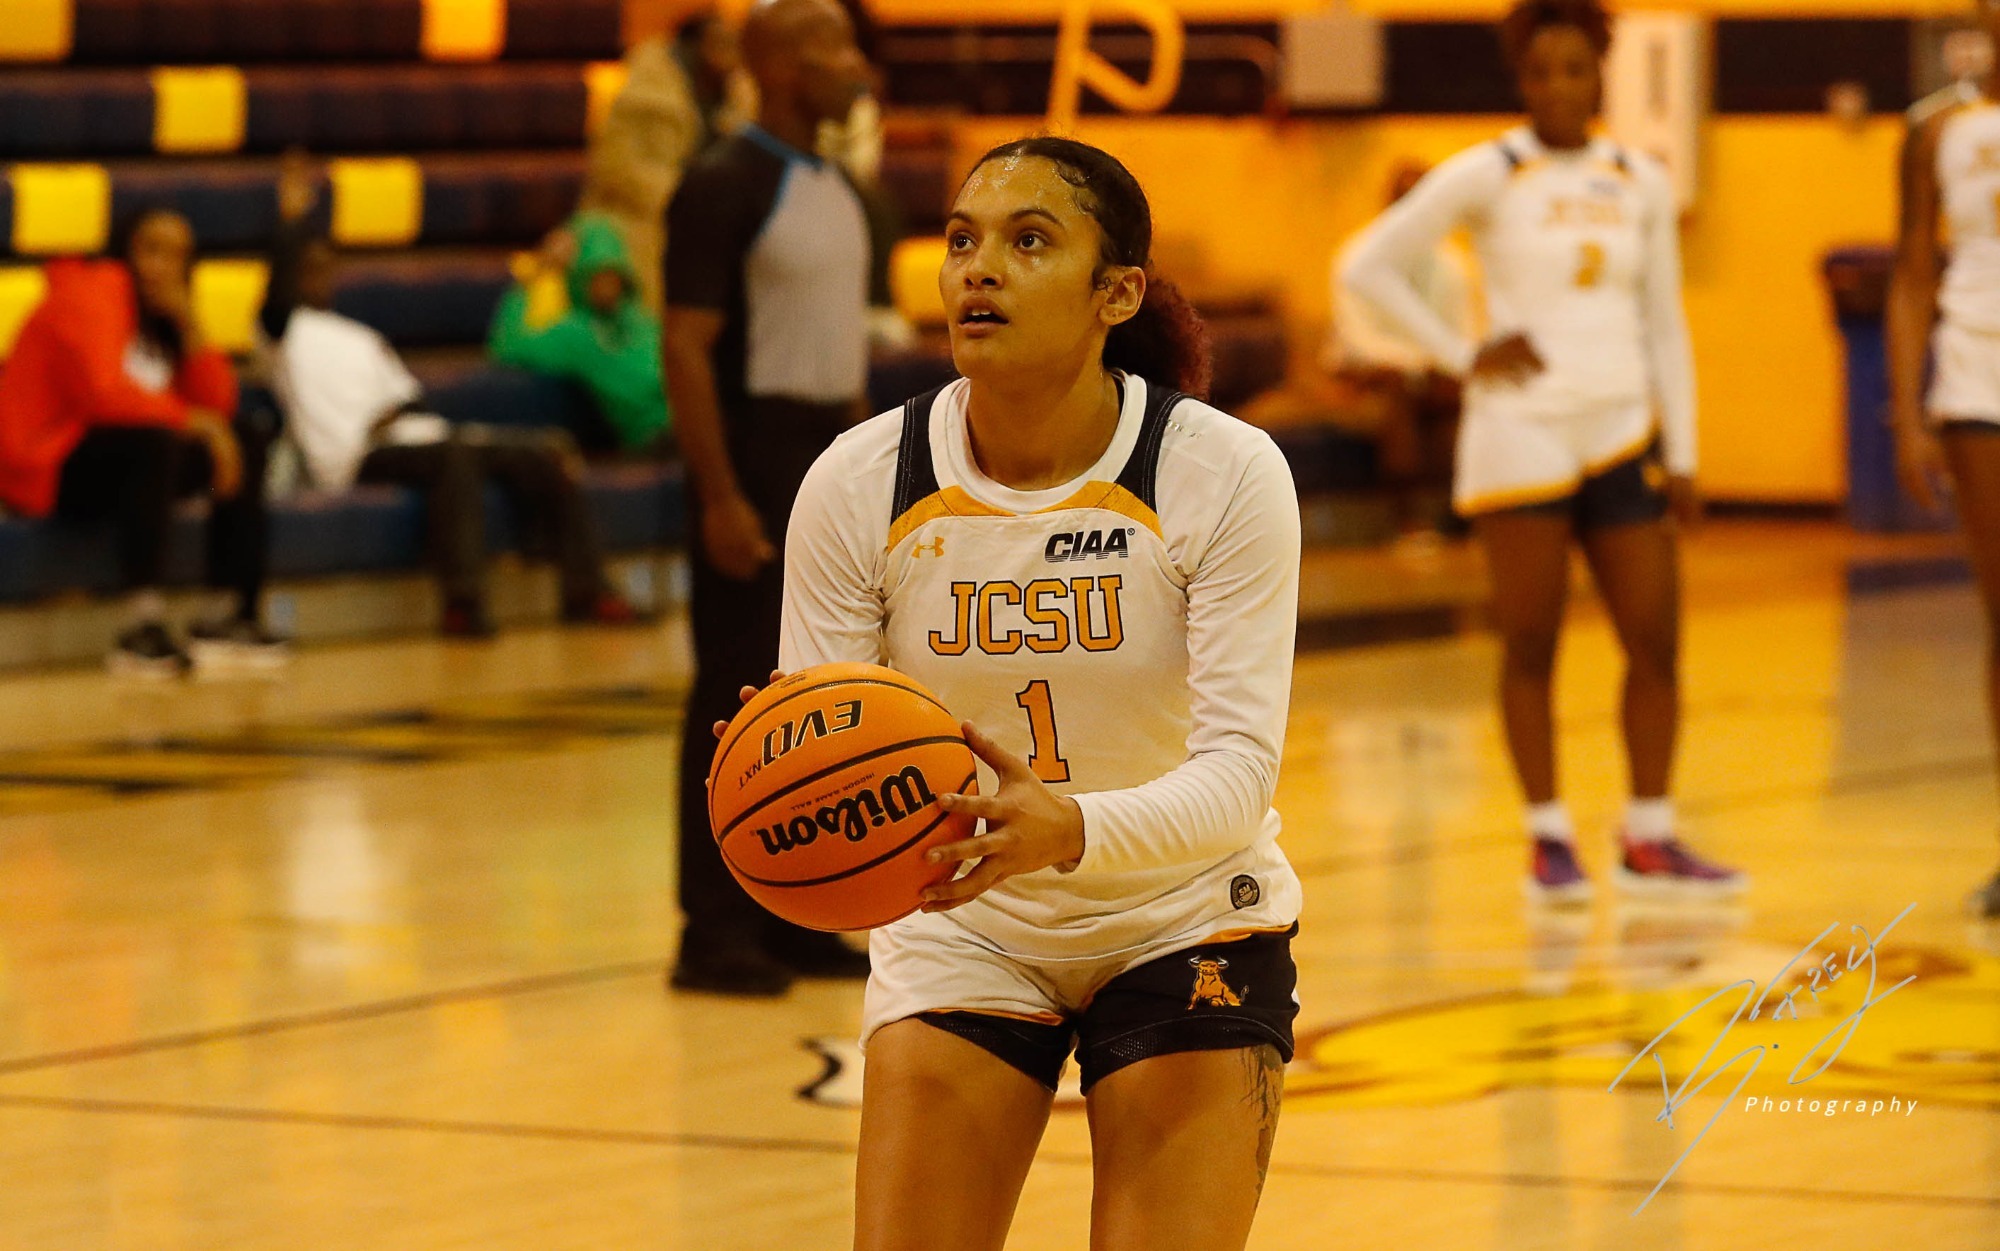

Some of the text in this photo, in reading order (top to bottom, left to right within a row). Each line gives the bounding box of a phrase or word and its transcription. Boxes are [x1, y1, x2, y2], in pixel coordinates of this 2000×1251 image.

[928, 573, 1125, 656] JCSU
[762, 699, 863, 767] EVO
[1015, 679, 1071, 784] 1
[738, 759, 763, 791] NXT
[790, 800, 812, 811] BALL
[842, 772, 875, 791] INDOOR
[756, 765, 938, 856] Wilson
